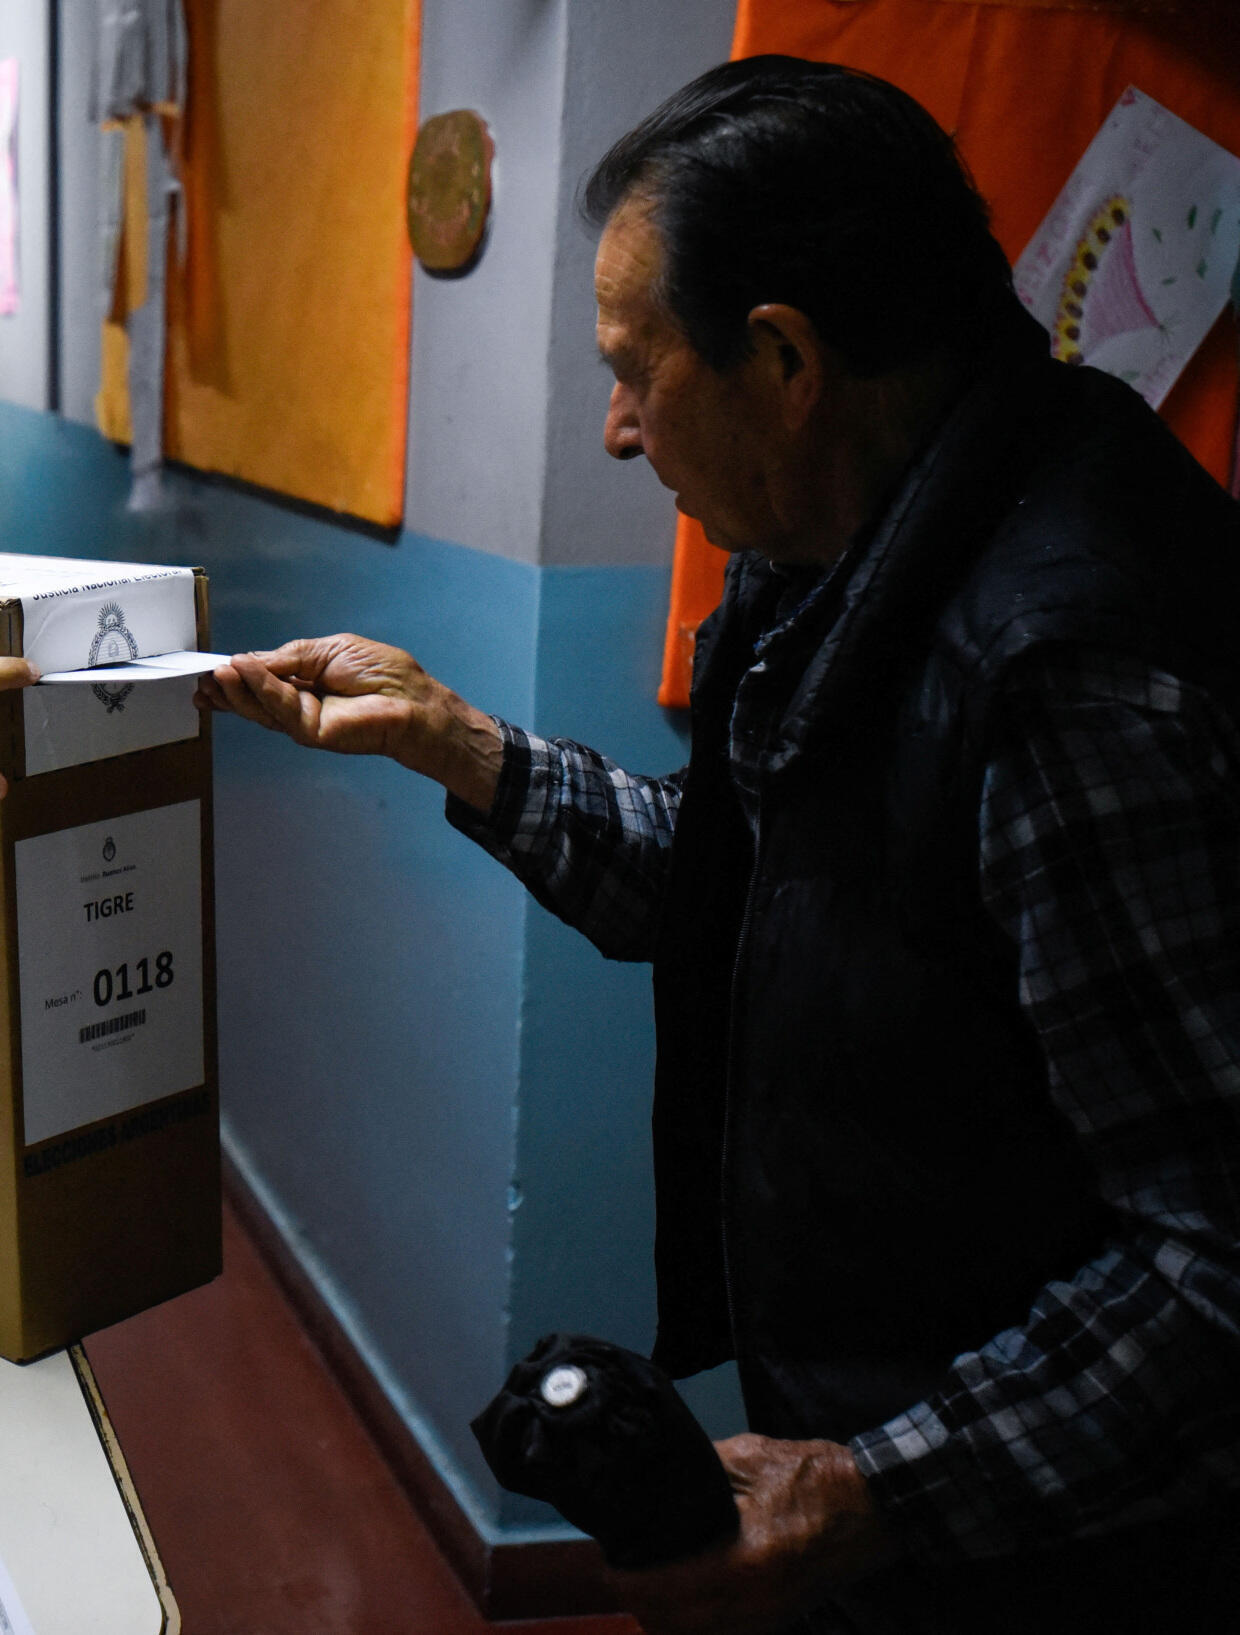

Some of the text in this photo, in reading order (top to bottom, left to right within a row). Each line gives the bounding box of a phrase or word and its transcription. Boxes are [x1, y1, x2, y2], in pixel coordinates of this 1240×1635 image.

[83, 892, 134, 922] TIGRE
[45, 996, 68, 1010] Mesa
[93, 951, 174, 1007] 0118
